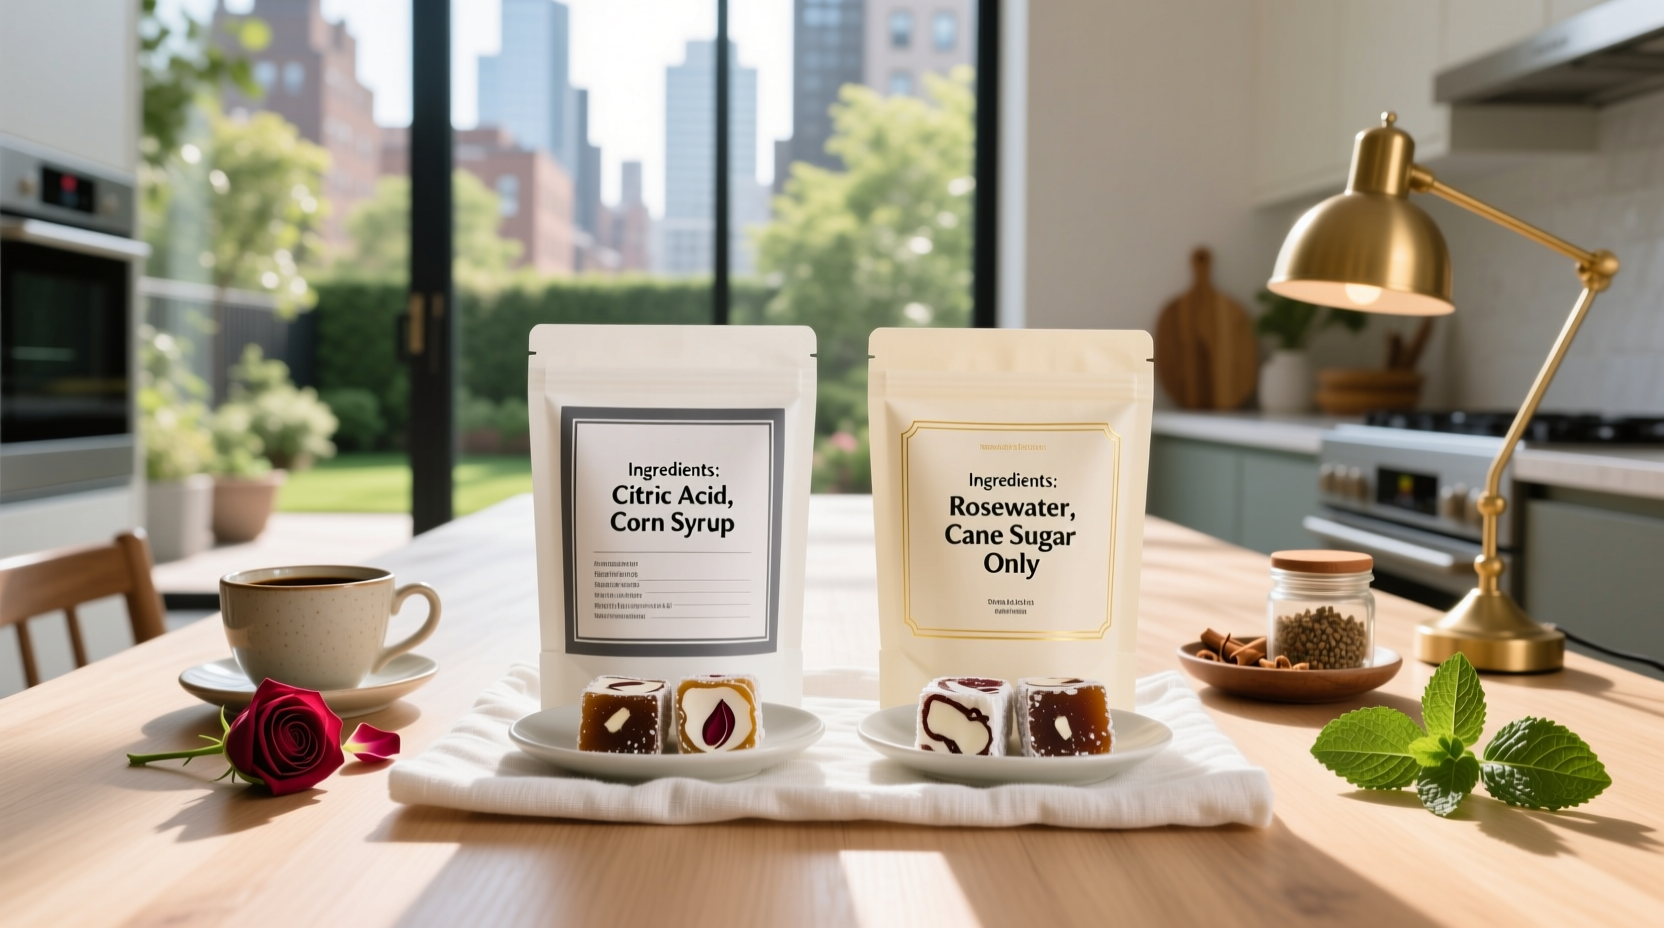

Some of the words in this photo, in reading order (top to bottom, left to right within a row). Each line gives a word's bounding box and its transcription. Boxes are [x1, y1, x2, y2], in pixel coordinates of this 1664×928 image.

[628, 461, 720, 481] Ingredients:
[969, 472, 1058, 491] Ingredients:
[611, 485, 672, 506] Citric
[677, 485, 734, 509] Acid,
[949, 495, 1076, 521] Rosewater,
[610, 511, 665, 532] Corn
[670, 511, 735, 539] Syrup
[944, 523, 1004, 545] Cane
[1009, 524, 1077, 552] Sugar
[983, 552, 1041, 580] Only
